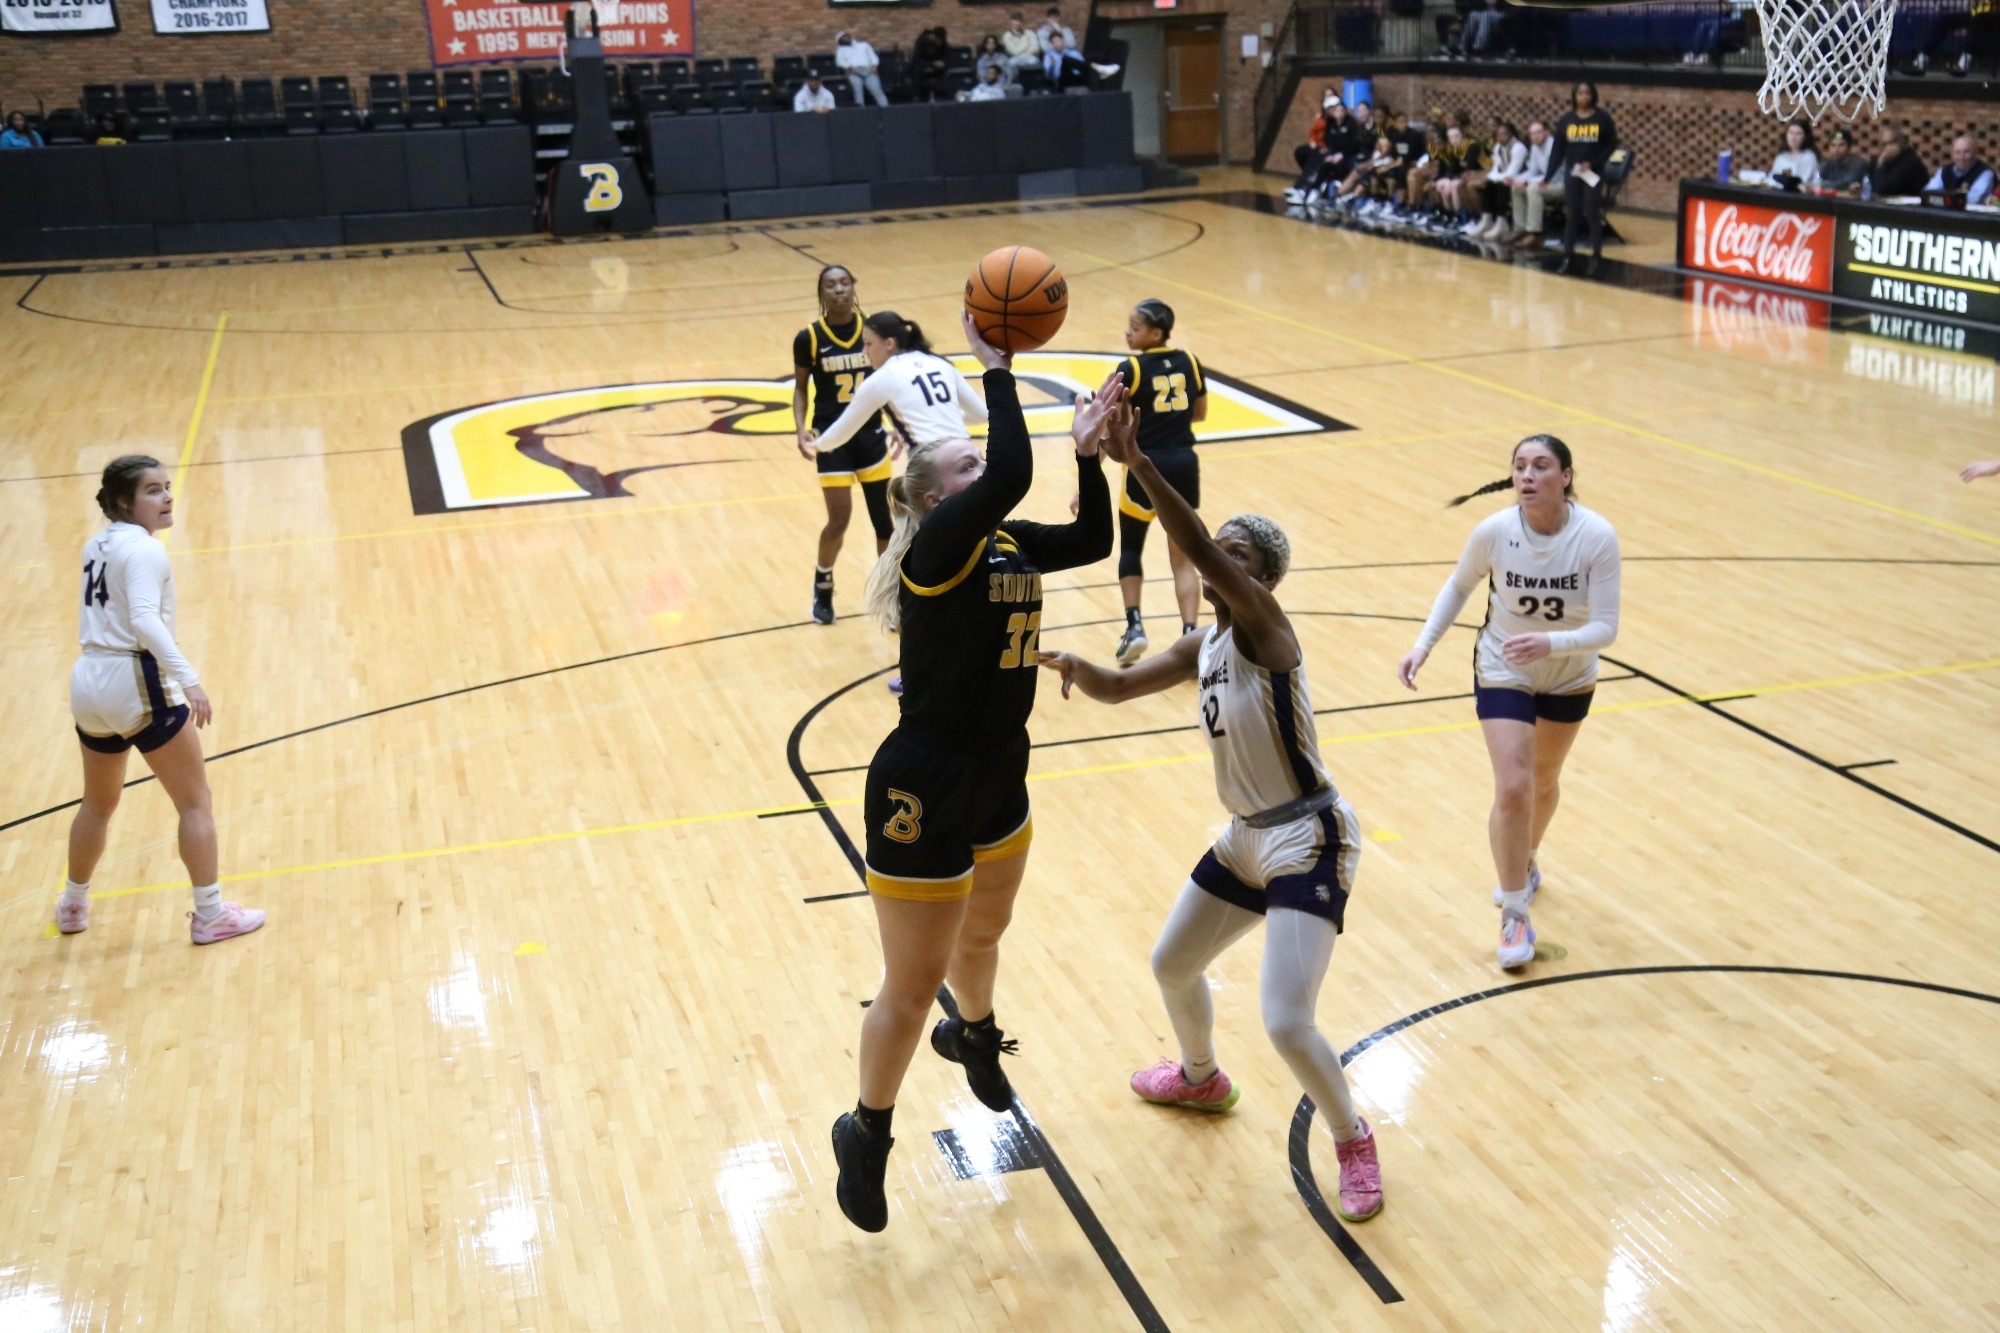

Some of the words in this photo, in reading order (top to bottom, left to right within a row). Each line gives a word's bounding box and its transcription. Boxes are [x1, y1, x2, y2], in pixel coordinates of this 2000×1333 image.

[174, 11, 247, 28] 2016-2017
[453, 6, 564, 31] BASKETBALL
[476, 31, 519, 53] 1995
[1710, 205, 1822, 284] Coca-Cola
[1870, 277, 1968, 314] ATHLETICS
[911, 370, 951, 407] 15
[1152, 372, 1189, 413] 23
[83, 559, 110, 608] 14
[1506, 571, 1578, 590] SEWANEE
[1518, 596, 1565, 621] 23
[1000, 611, 1042, 669] 32
[883, 788, 923, 844] B
